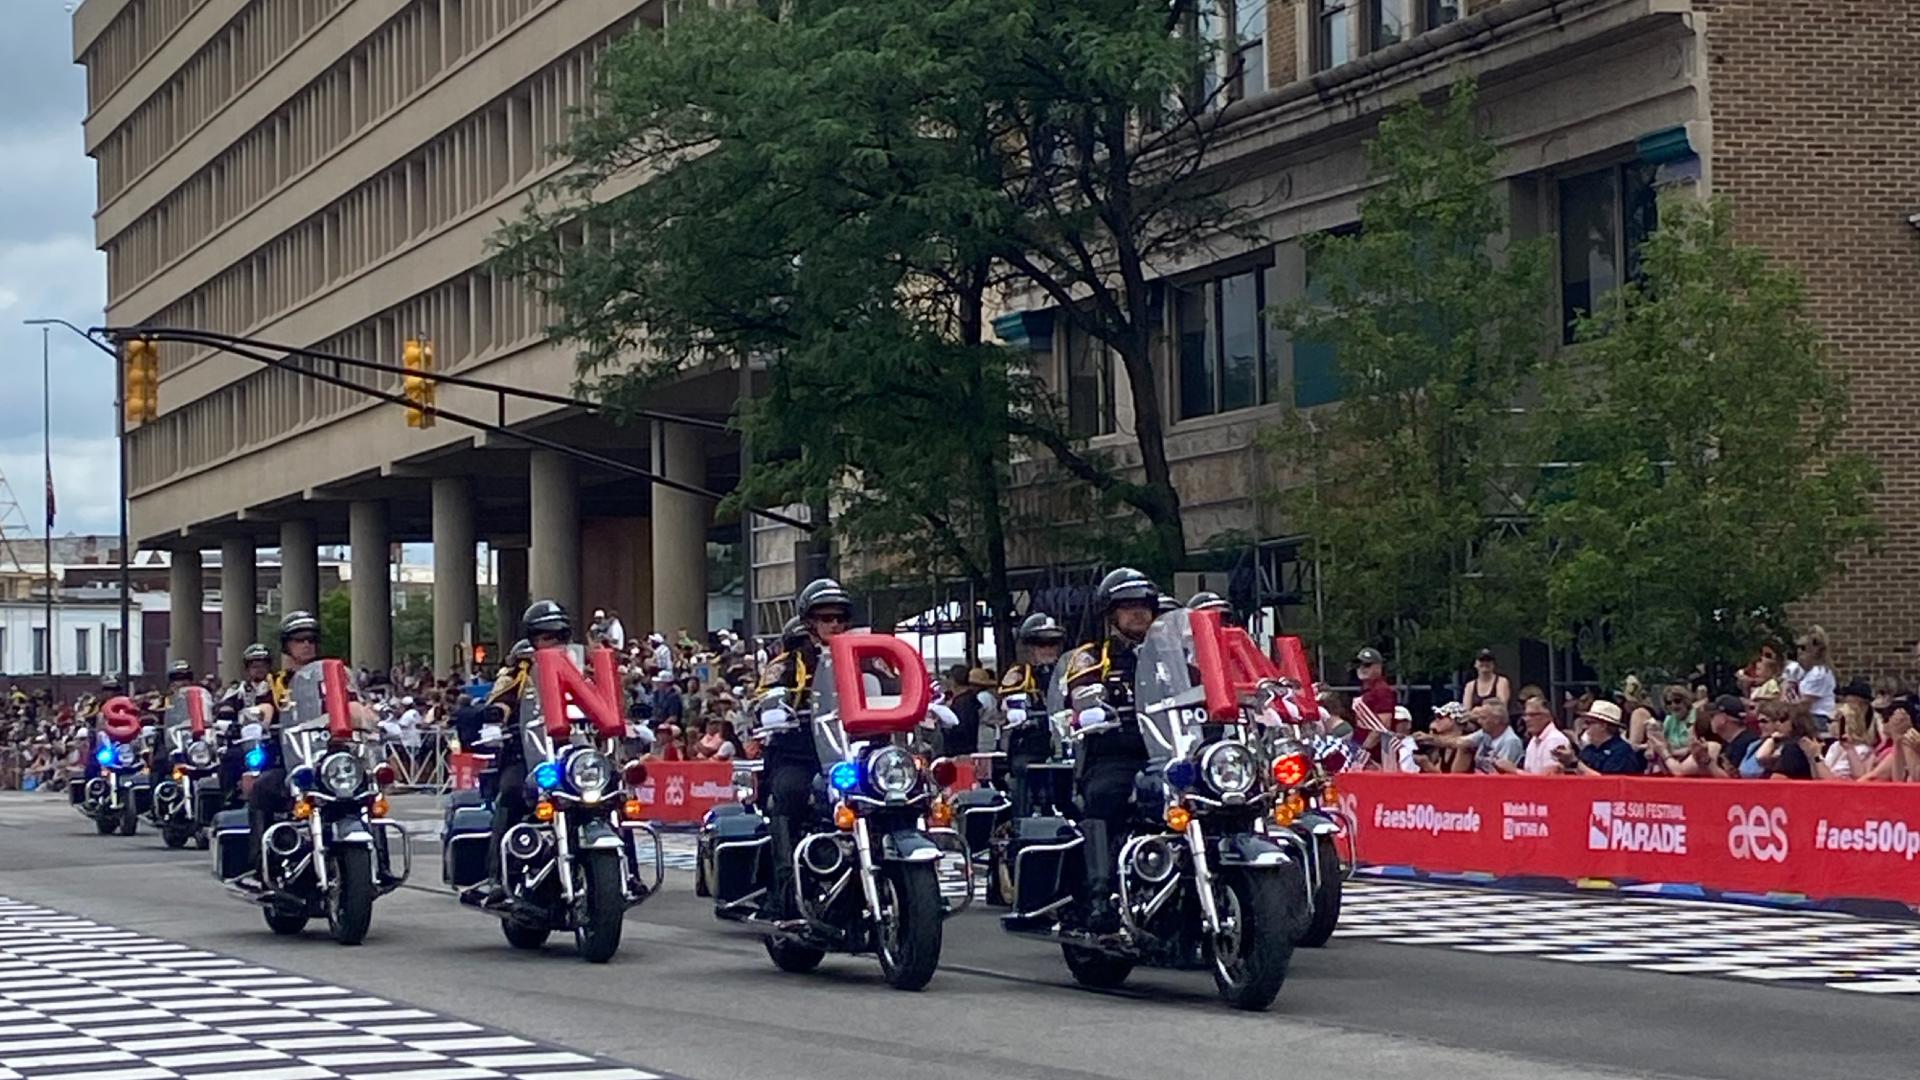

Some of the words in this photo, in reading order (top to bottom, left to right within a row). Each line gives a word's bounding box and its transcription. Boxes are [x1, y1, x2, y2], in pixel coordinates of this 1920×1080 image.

[537, 648, 626, 736] N
[831, 634, 929, 734] D
[101, 696, 140, 742] S
[1374, 803, 1481, 836] #aes500parade
[1627, 802, 1644, 818] 500
[1645, 803, 1687, 820] FESTIVAL
[1727, 804, 1788, 863] aes
[1611, 819, 1687, 854] PARADE
